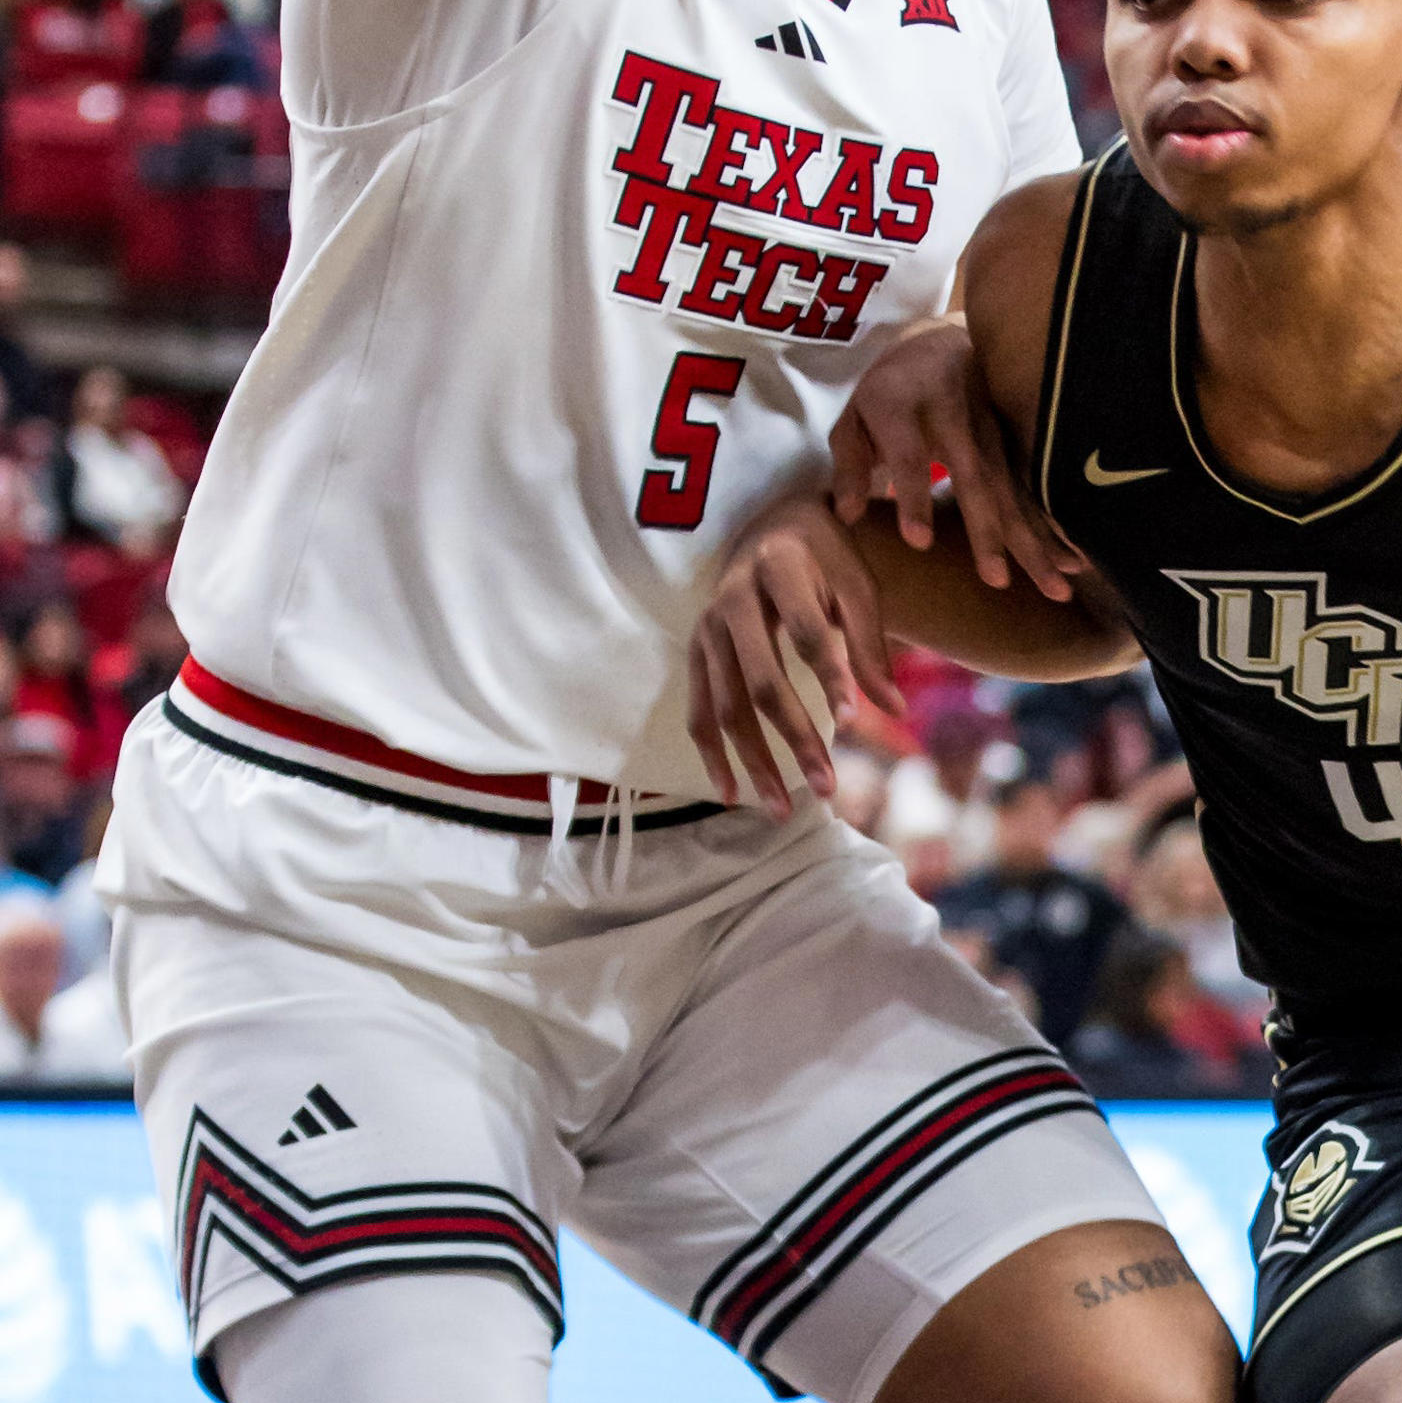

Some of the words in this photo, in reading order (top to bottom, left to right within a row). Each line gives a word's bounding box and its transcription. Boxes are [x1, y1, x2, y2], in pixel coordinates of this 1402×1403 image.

[611, 48, 940, 245] TEXAS
[611, 174, 891, 344] TECH
[635, 350, 747, 532] 5
